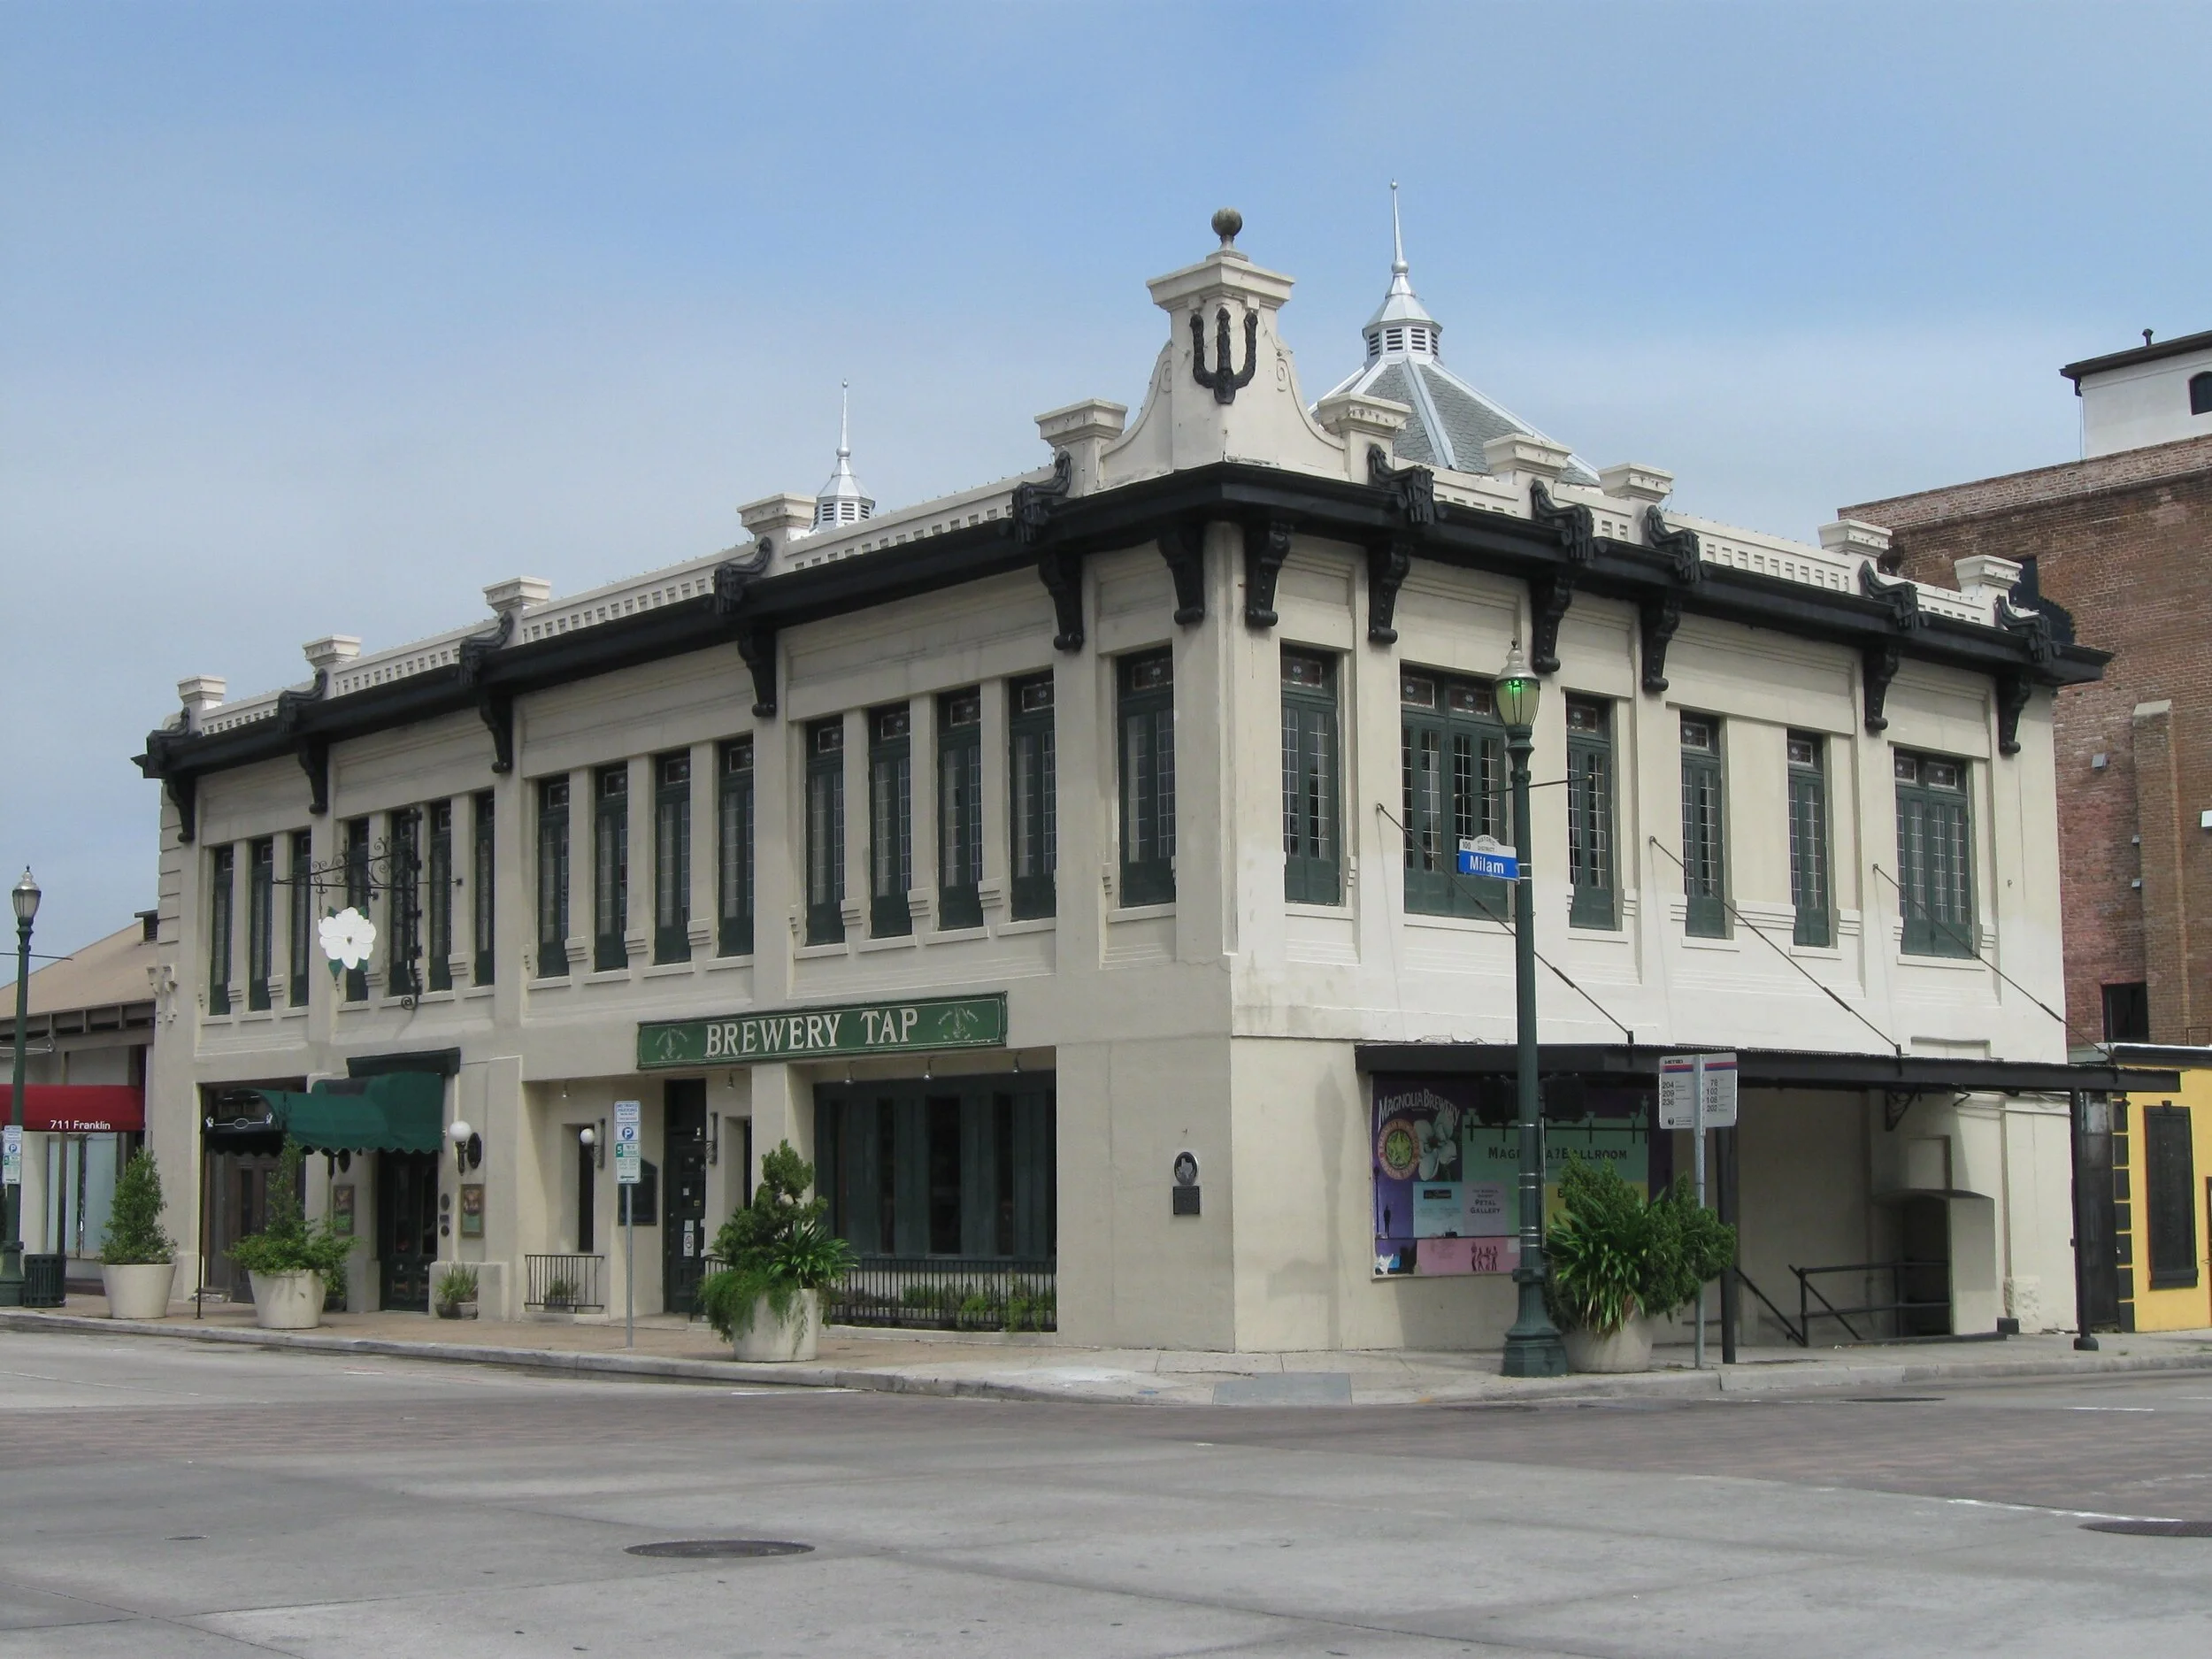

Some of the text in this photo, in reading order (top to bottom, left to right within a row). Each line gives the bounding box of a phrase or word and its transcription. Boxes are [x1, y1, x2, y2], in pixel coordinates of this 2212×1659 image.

[1470, 855, 1504, 874] Milam
[706, 1012, 841, 1057] BREWERY
[860, 1007, 918, 1045] TAP
[50, 1119, 111, 1131] 711 Franklin
